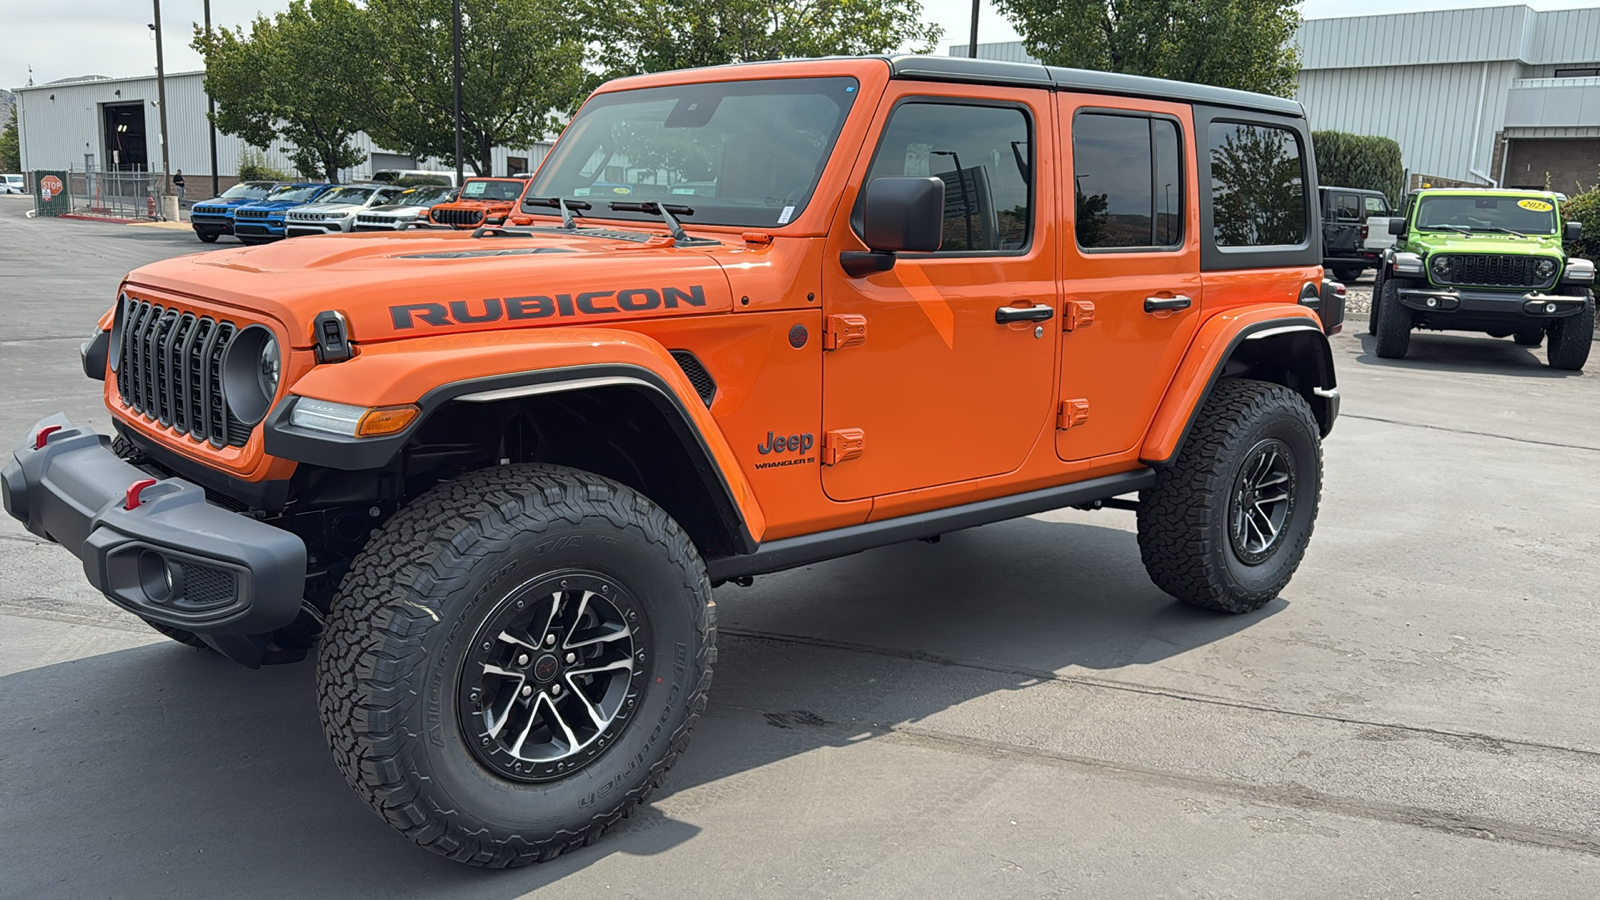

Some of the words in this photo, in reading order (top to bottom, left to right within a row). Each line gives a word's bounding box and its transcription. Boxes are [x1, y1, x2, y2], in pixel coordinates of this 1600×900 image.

[43, 181, 61, 189] STOP
[1523, 201, 1548, 210] 2025
[389, 285, 706, 330] RUBICON
[758, 431, 814, 455] Jeep
[755, 458, 806, 470] WRANGLER
[534, 534, 583, 557] T/A
[578, 641, 687, 809] BFGoodrich
